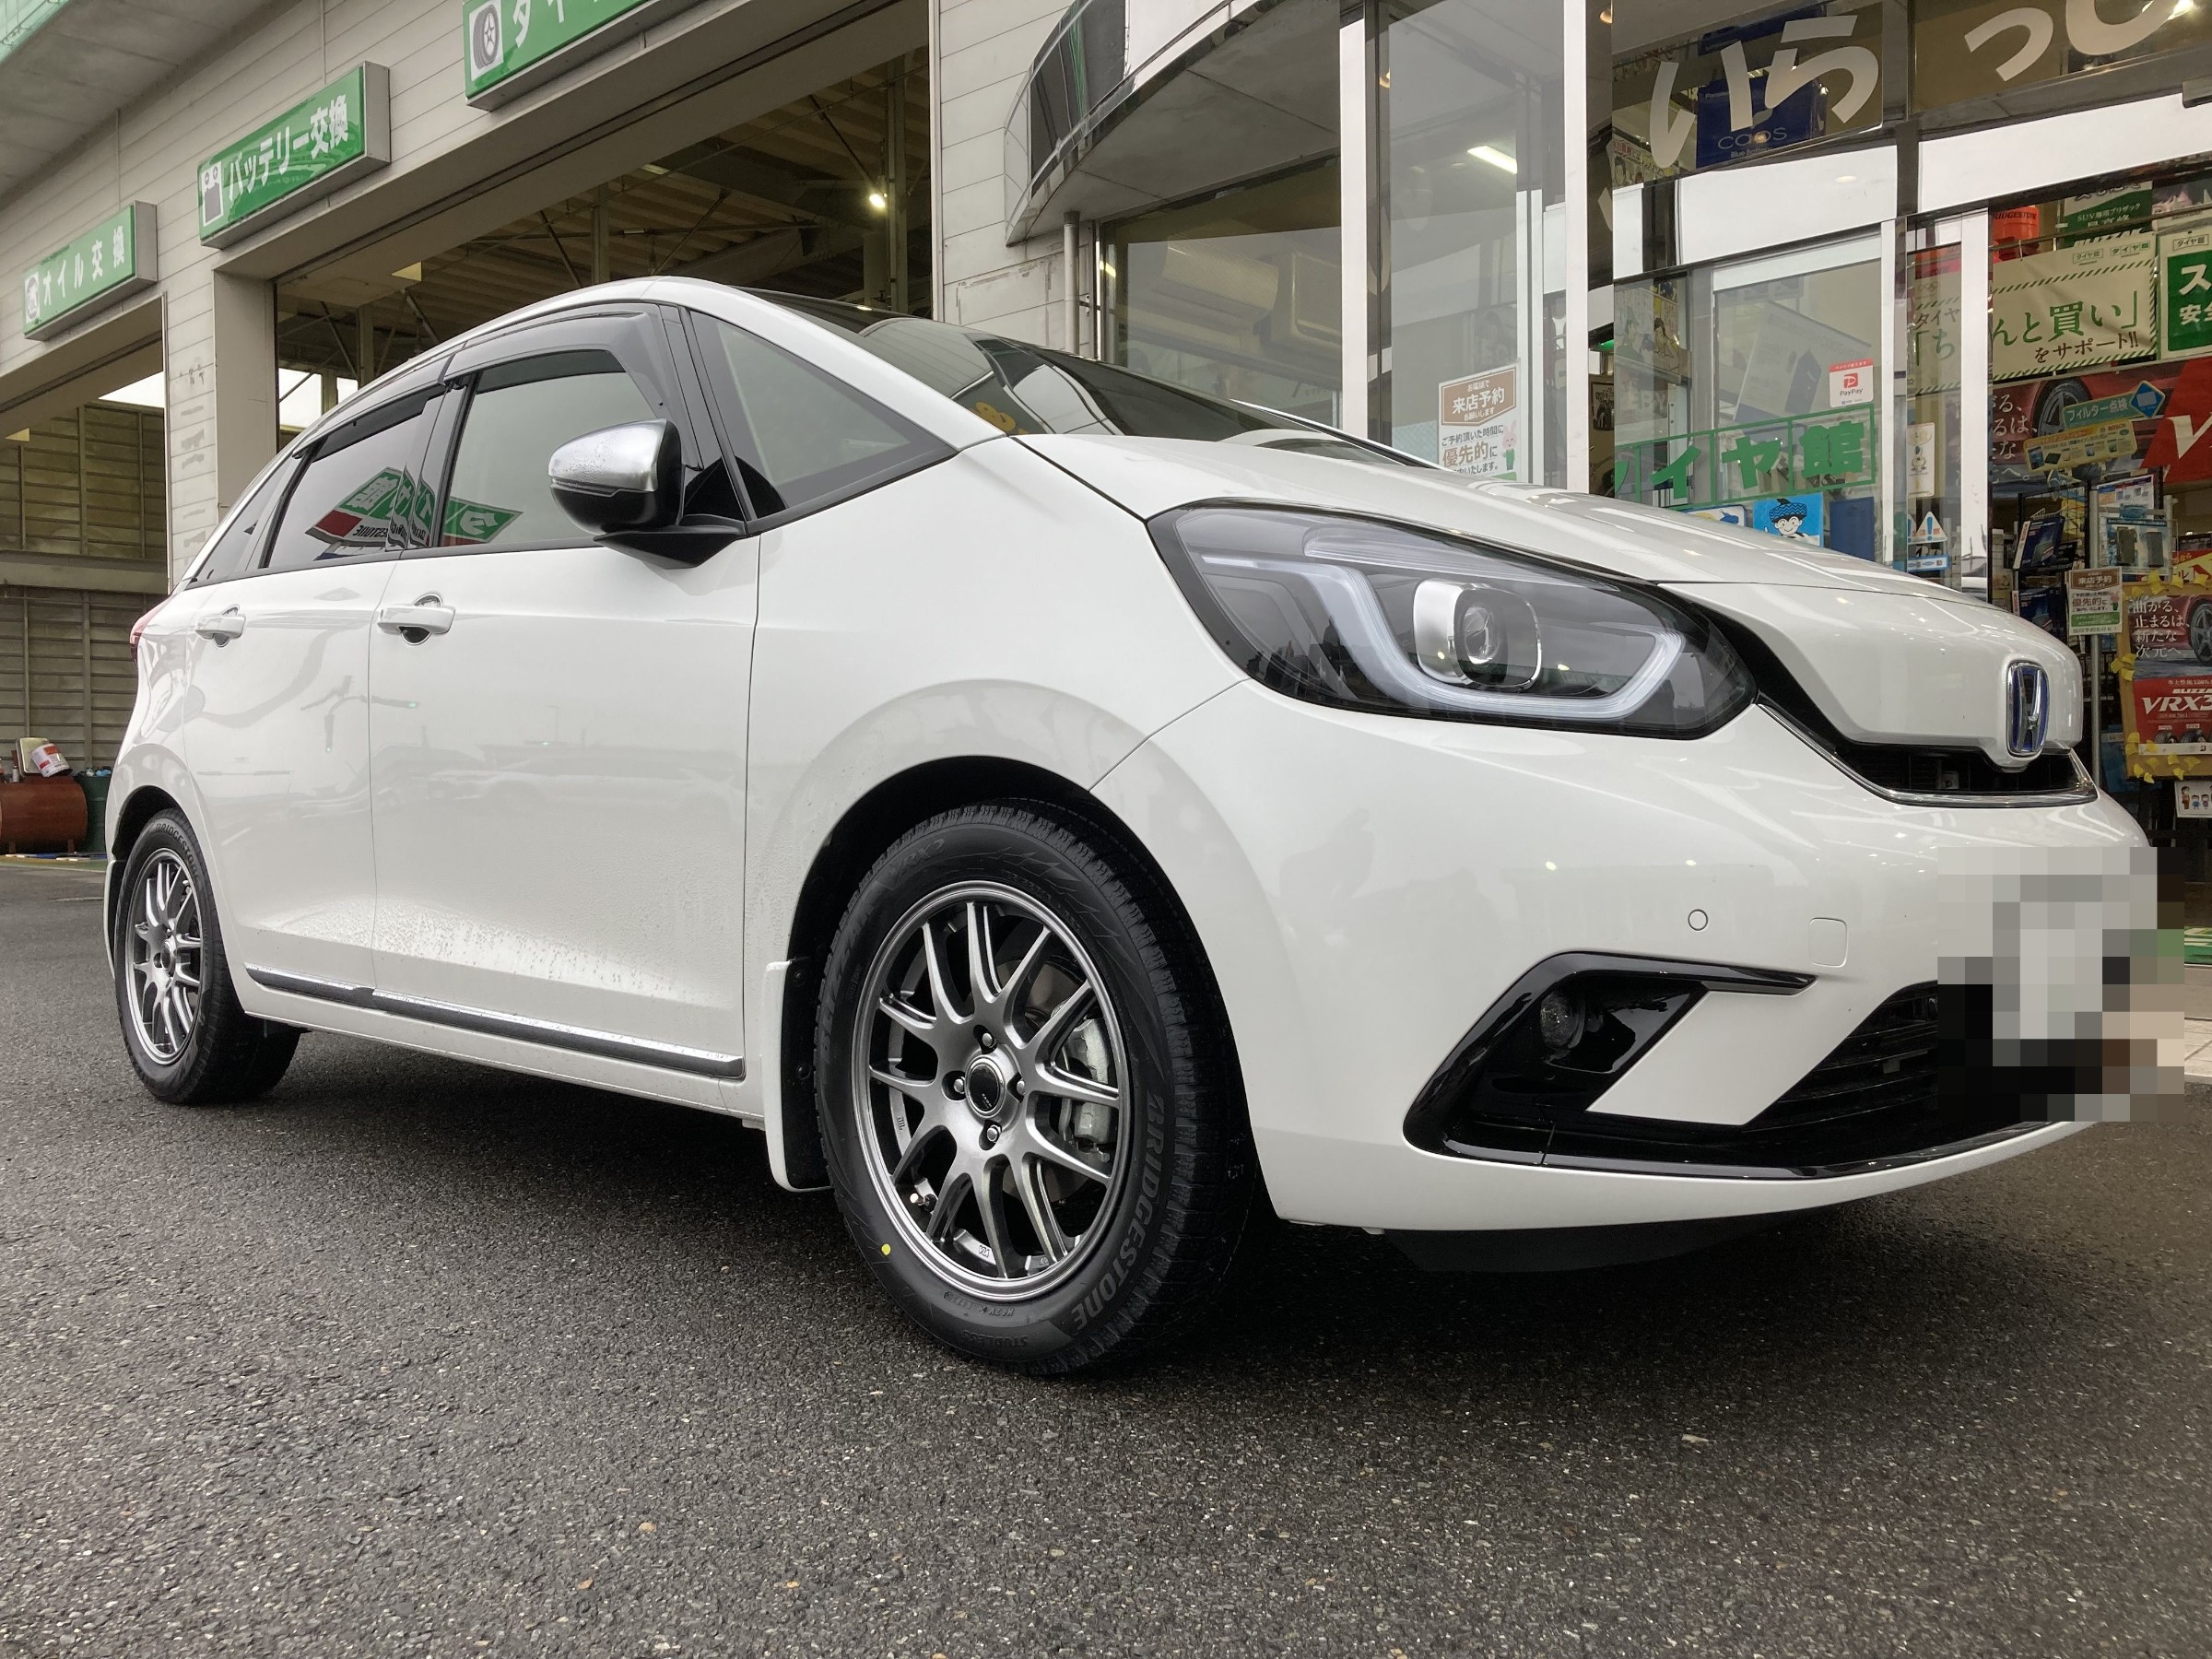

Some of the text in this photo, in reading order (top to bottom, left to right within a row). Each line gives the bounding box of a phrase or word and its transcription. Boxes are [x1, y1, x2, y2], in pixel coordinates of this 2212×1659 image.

[229, 94, 349, 205] バッテリー交換
[42, 225, 125, 306] オイル交換
[1453, 387, 1505, 415] 来店予約
[1840, 387, 1864, 397] PayPay
[2066, 397, 2129, 422] フィルター点検
[1441, 424, 1504, 447] ご予約頂いた時間に
[1442, 441, 1498, 468] 優先的に
[2135, 614, 2191, 629] 止まるは、
[1070, 1090, 1165, 1330] BRIDGESTONE
